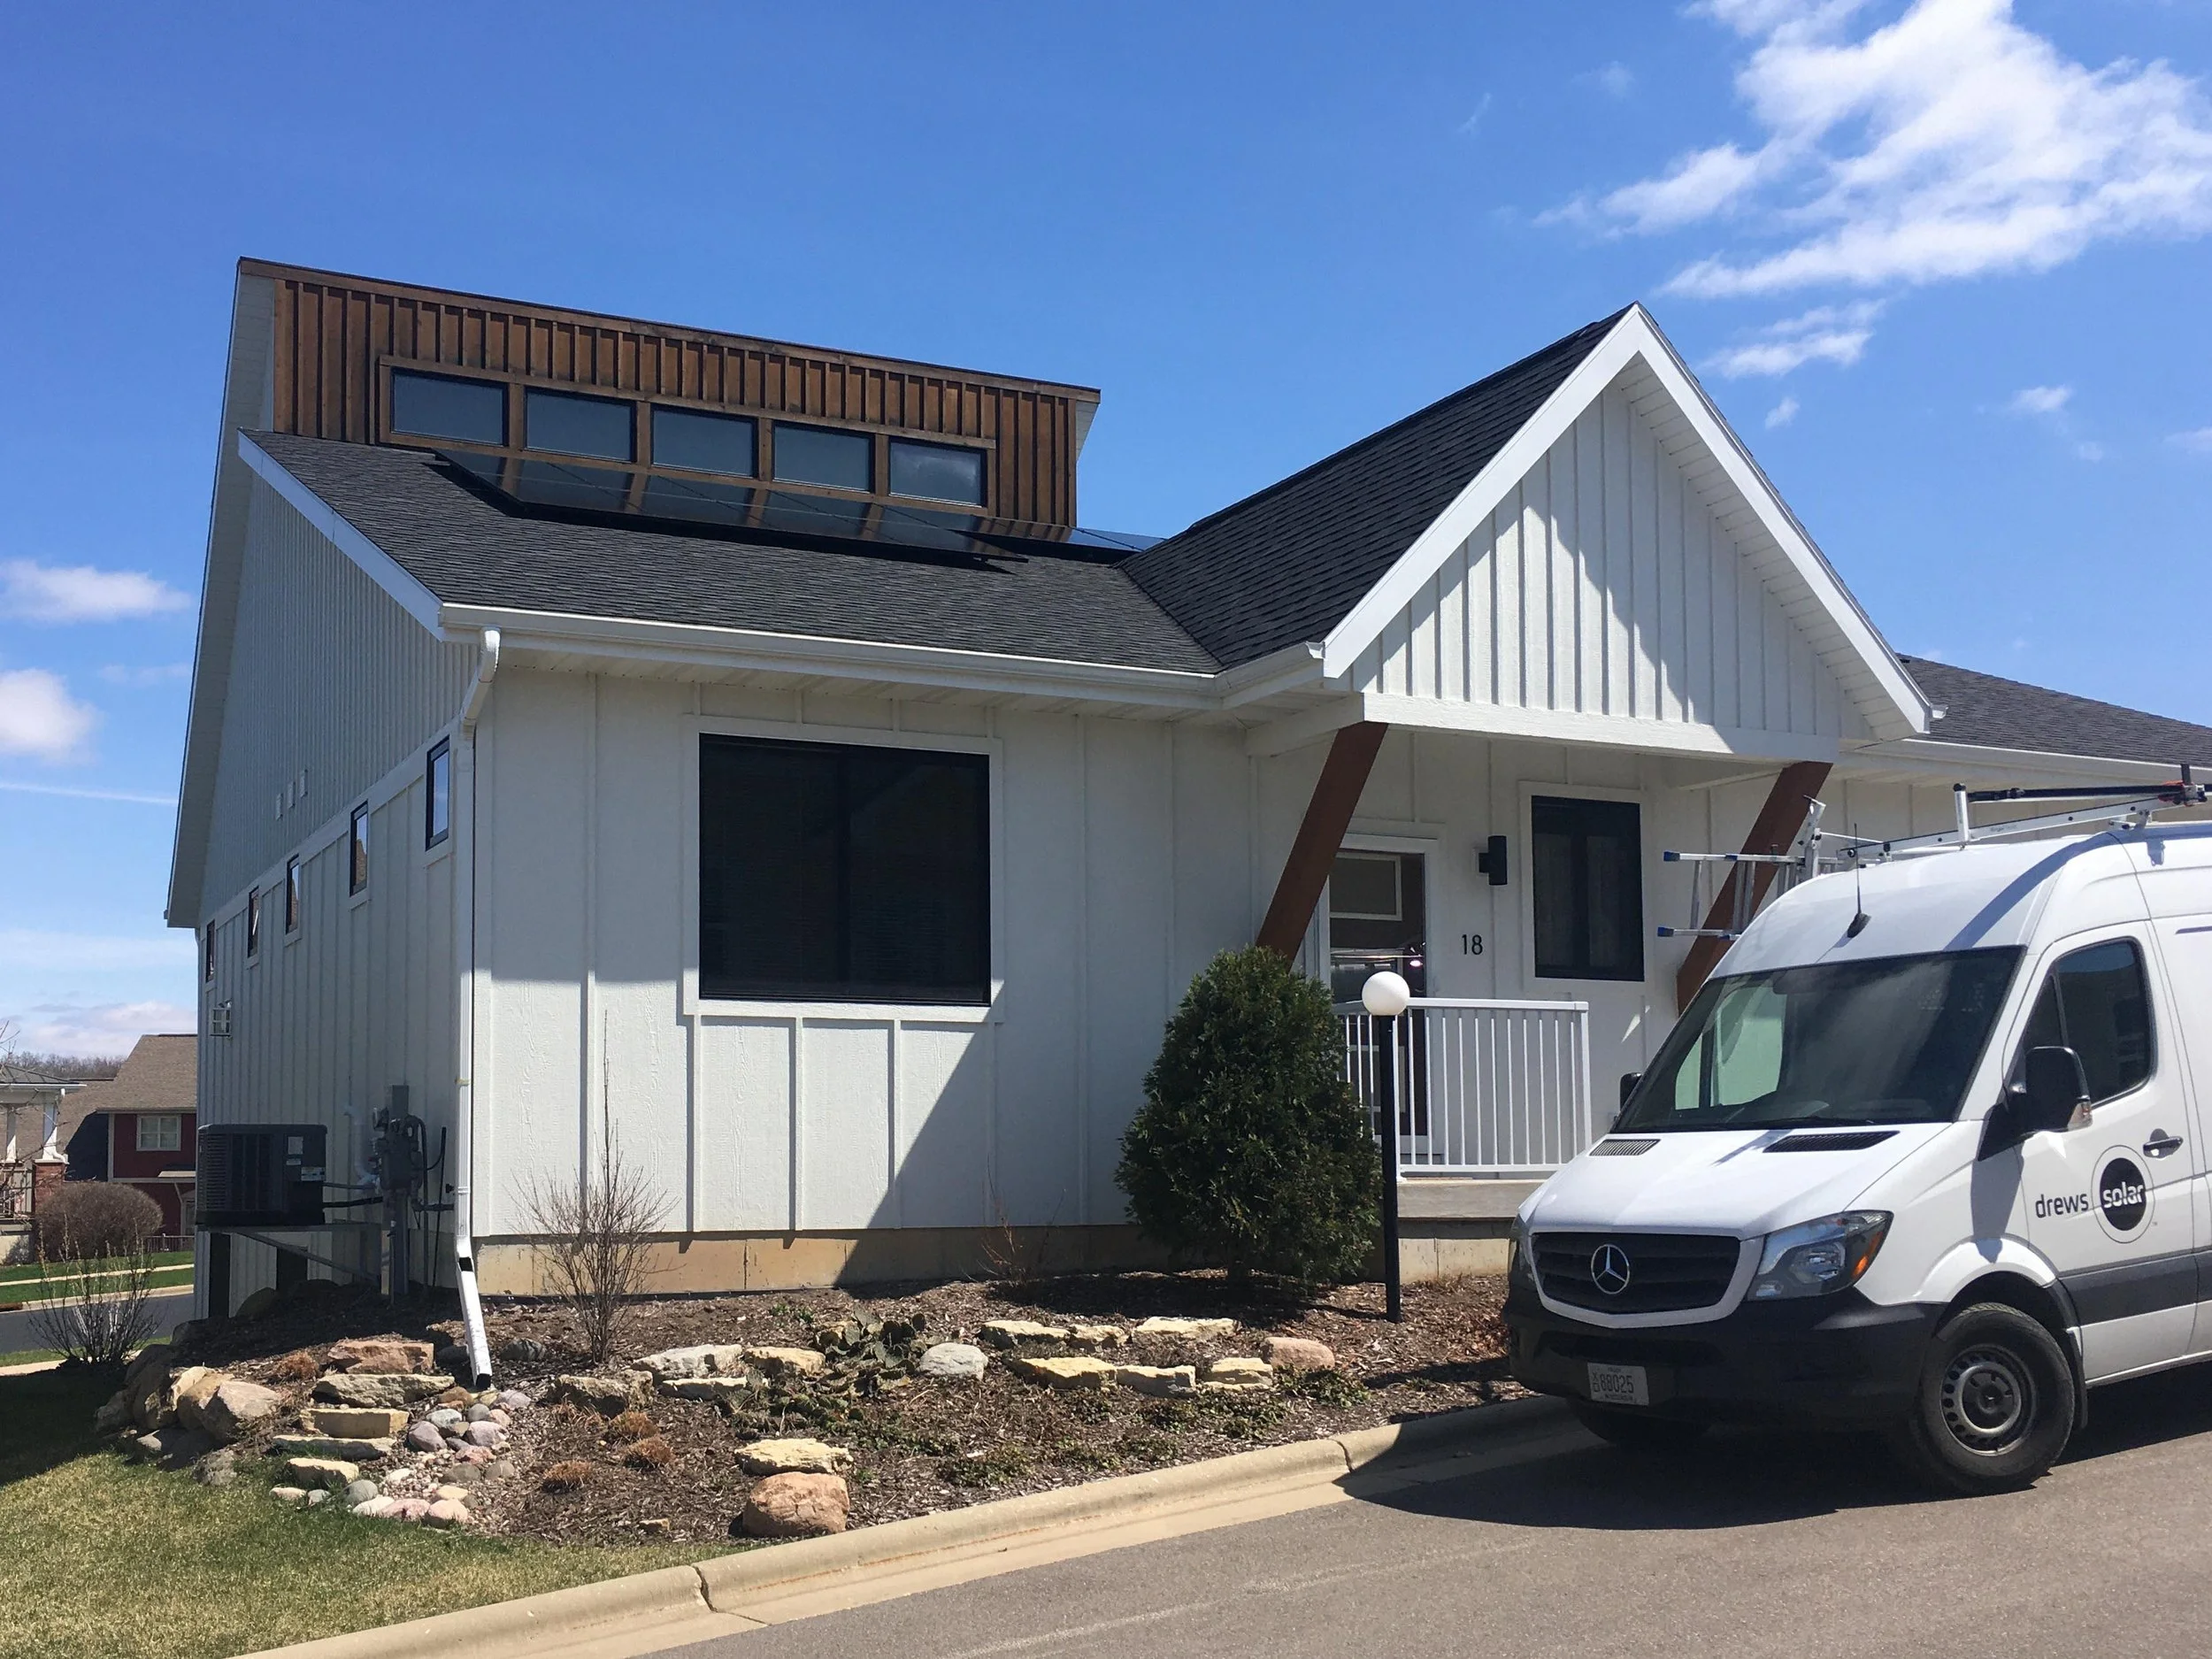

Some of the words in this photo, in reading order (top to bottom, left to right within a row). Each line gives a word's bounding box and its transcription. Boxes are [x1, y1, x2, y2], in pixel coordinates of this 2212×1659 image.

[1462, 933, 1483, 956] 18
[2035, 1194, 2089, 1218] drews
[2102, 1181, 2144, 1209] solar
